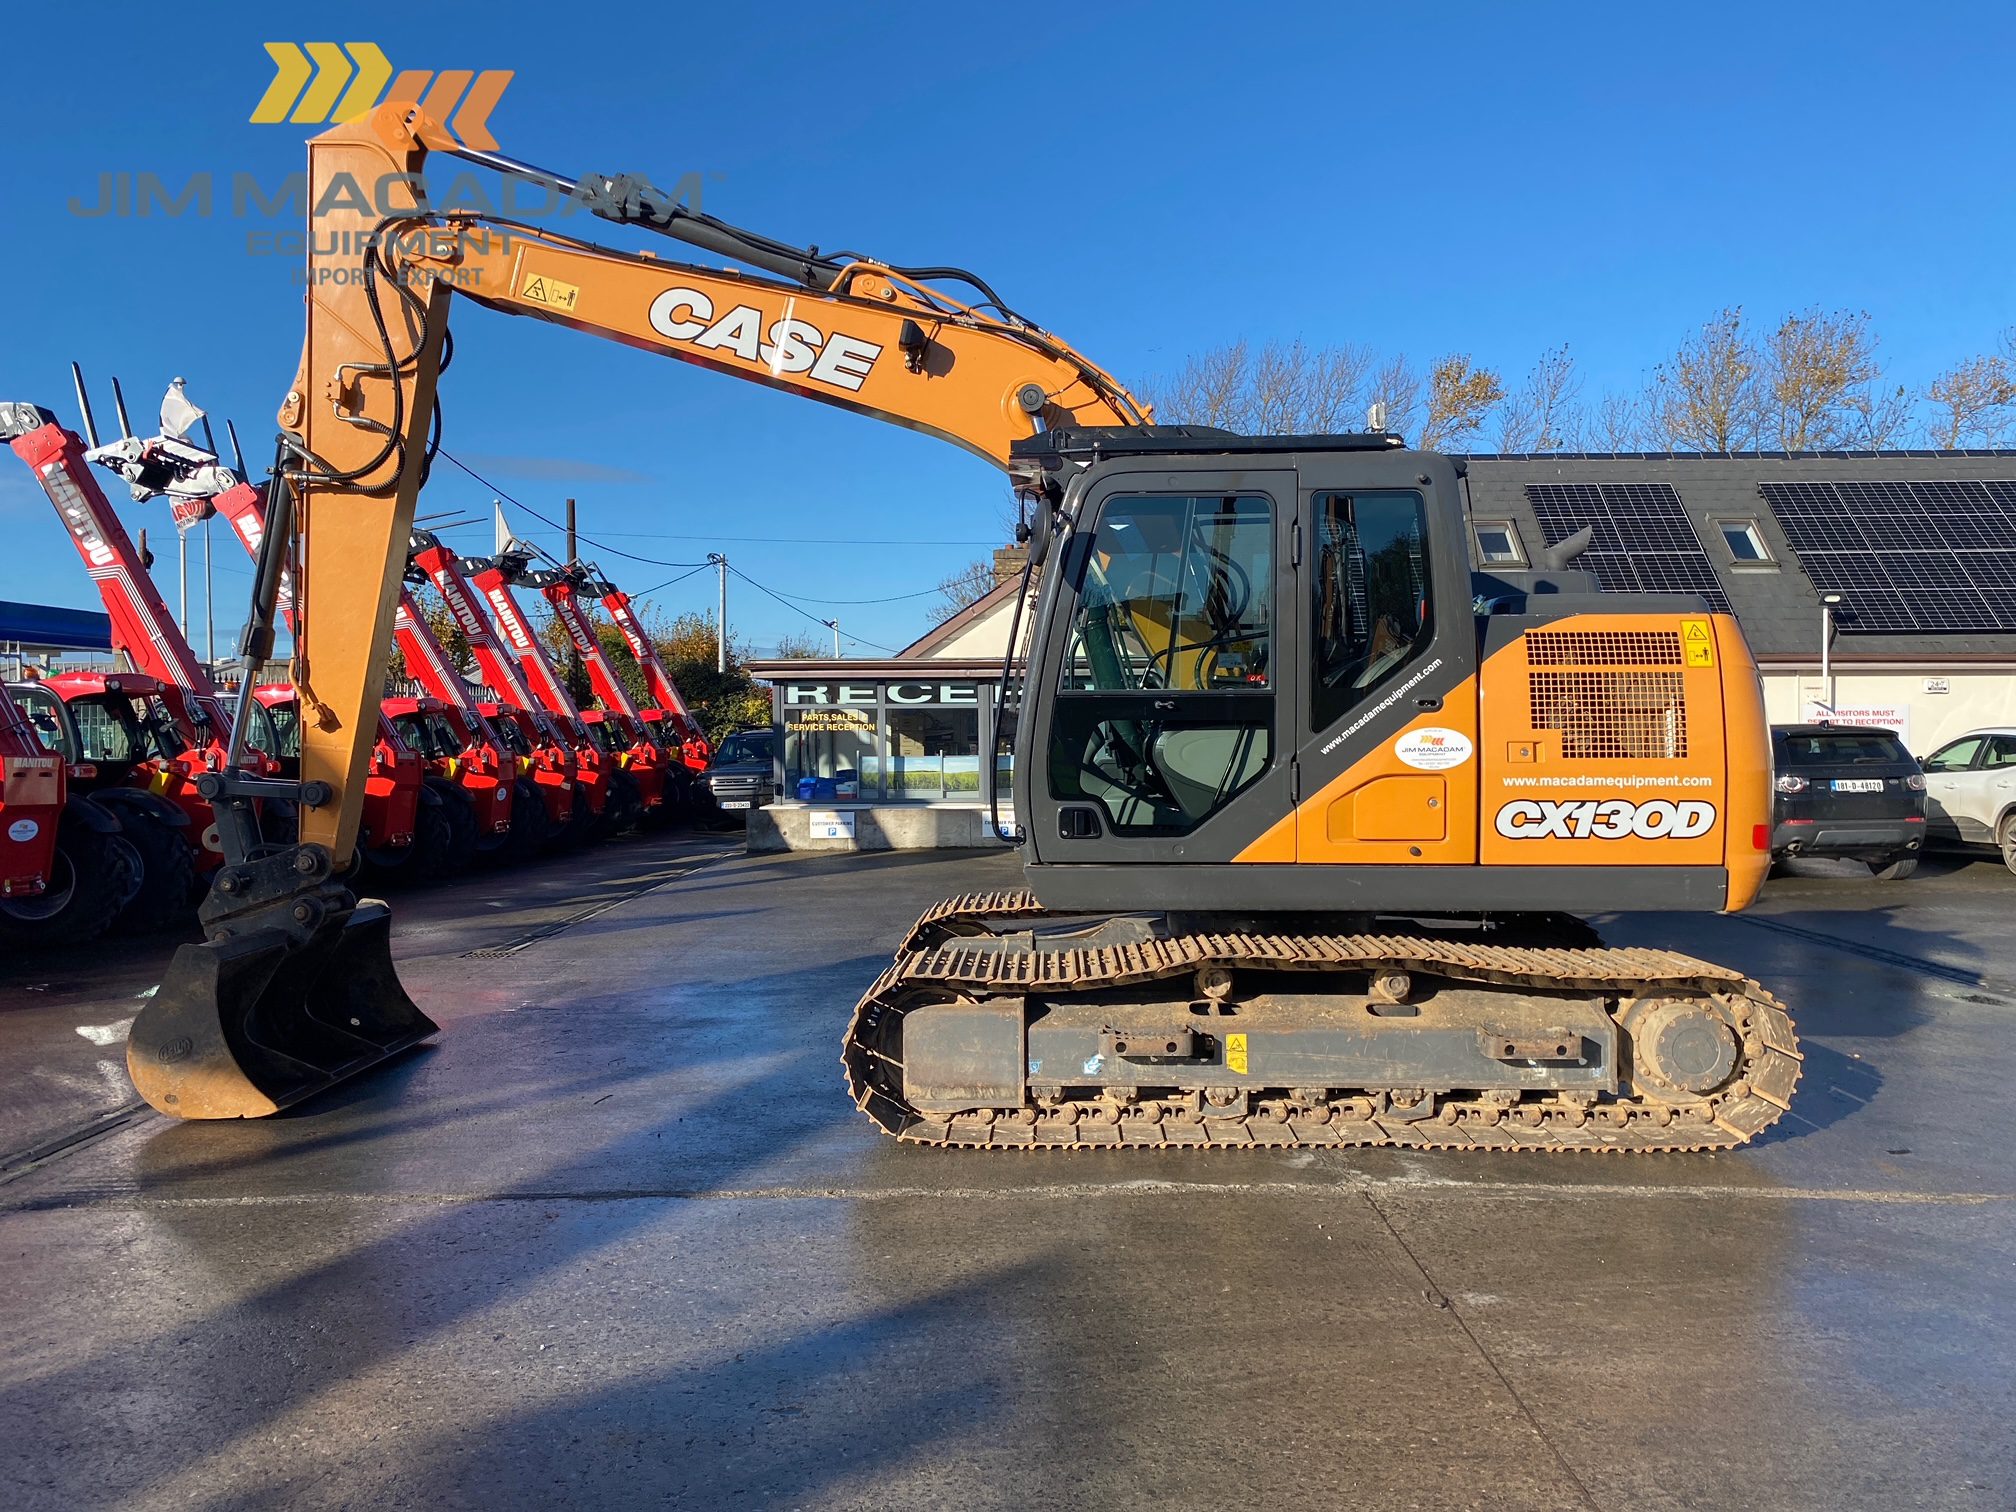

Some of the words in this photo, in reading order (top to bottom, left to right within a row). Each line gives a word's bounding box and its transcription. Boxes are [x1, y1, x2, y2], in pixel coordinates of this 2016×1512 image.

[648, 286, 885, 393] CASE
[40, 461, 115, 566] MANITOU
[433, 569, 482, 635] MANITOU
[487, 588, 530, 648] MANITOU
[556, 600, 594, 653] MANITOU
[613, 608, 649, 657] MANITOU
[788, 723, 825, 731] SERVICE
[826, 723, 875, 731] RECEPTION
[1320, 658, 1443, 755] www.macadamequipment.com
[13, 757, 53, 768] MANITOU
[1503, 775, 1712, 788] www.macadamequipment.com
[1836, 781, 1881, 791] 181-D-48120
[1494, 799, 1717, 840] CX130D
